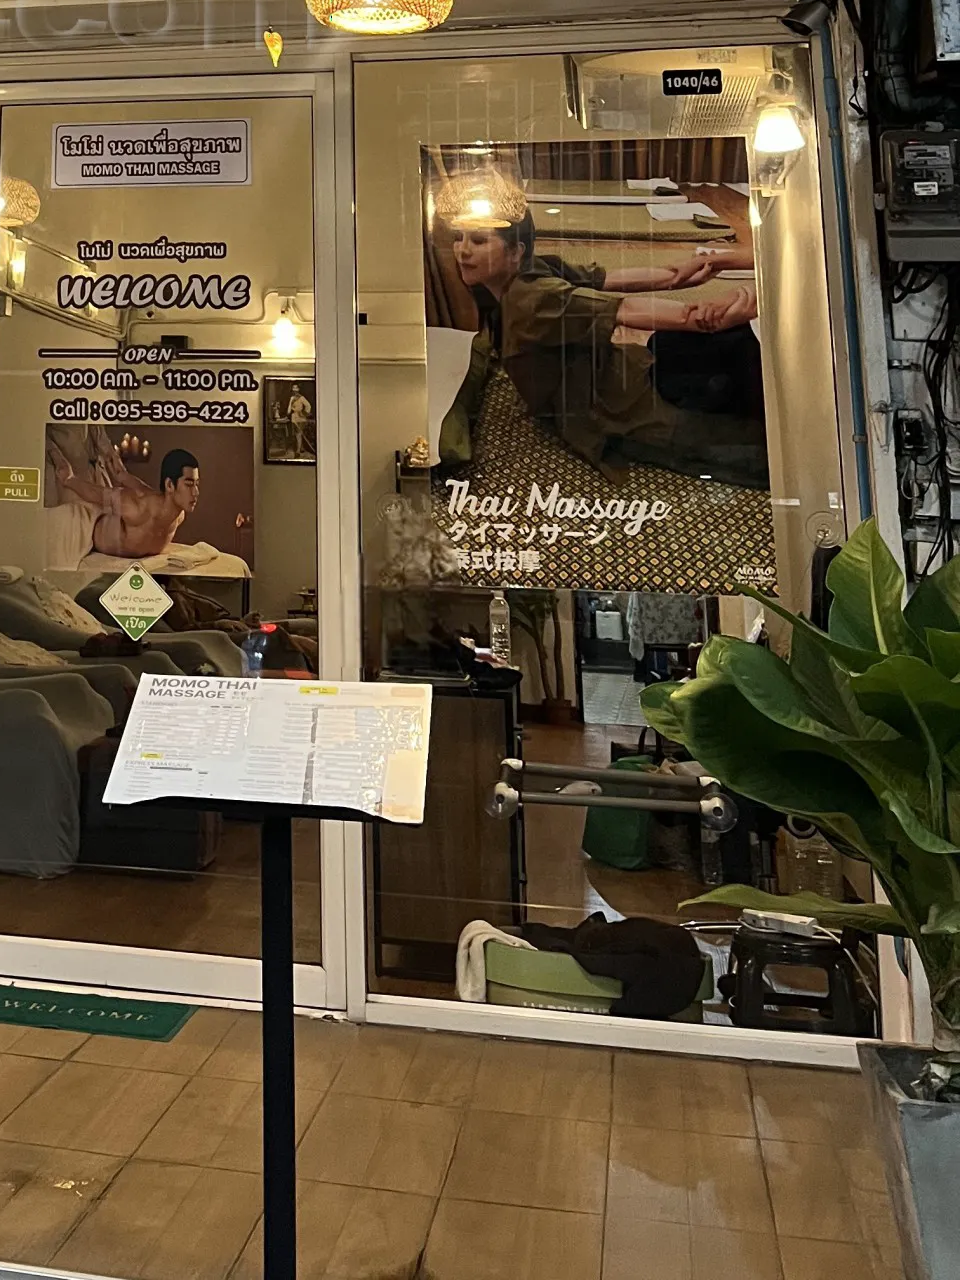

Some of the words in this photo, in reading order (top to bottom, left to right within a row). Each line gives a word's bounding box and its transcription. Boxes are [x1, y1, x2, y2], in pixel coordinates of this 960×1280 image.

[666, 71, 719, 93] 1040/46
[60, 135, 104, 157] โมโม่
[108, 128, 242, 161] นวดเพื่อสุขภาพ
[82, 163, 123, 177] MOMO
[126, 162, 155, 176] THAI
[157, 161, 220, 175] MASSAGE
[78, 240, 113, 259] โมโม่
[118, 236, 227, 263] นวดเพื่อสุขภาพ
[57, 274, 251, 310] WELCOME
[123, 347, 174, 364] OPEN
[43, 369, 96, 390] 10:00
[163, 371, 215, 391] 11:00
[51, 399, 87, 420] Call
[104, 402, 249, 423] 095-396-4224
[9, 468, 25, 483] ดึง
[4, 486, 30, 497] PULL
[445, 478, 520, 517] Thai
[525, 481, 673, 536] Massage
[109, 593, 162, 604] Welcome
[125, 616, 147, 629] เปิด
[148, 688, 227, 699] MASSAGE
[151, 677, 210, 689] MOMO
[216, 679, 258, 691] THAI
[2, 998, 156, 1022] WELCOME
